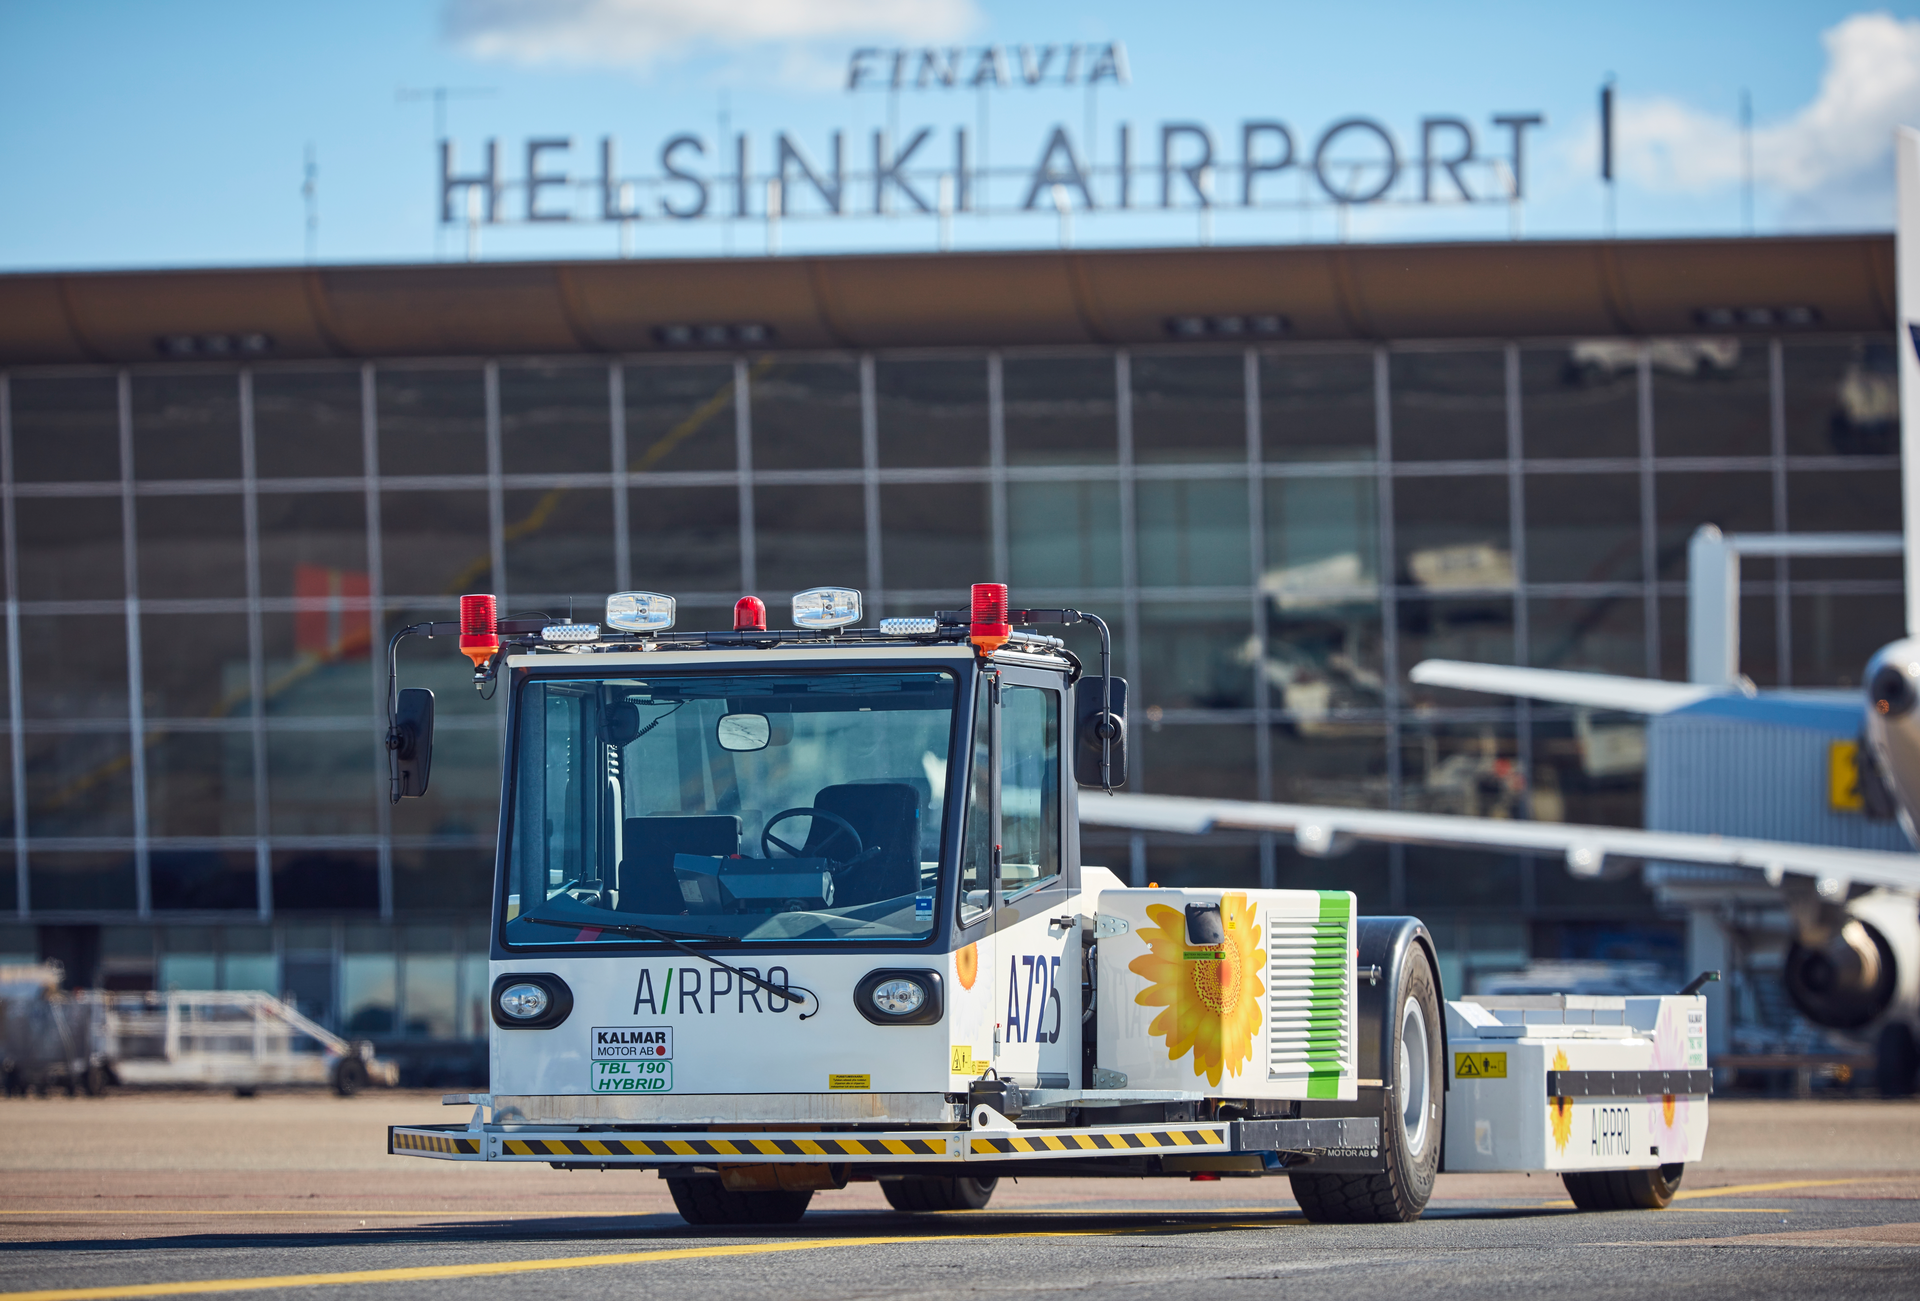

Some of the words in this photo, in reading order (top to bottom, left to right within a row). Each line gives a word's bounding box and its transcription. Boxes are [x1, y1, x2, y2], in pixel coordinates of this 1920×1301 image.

[847, 43, 1128, 89] FINAVIA
[440, 126, 970, 223] HELSINKI
[1023, 114, 1543, 210] AIRPORT
[1006, 954, 1062, 1045] A725
[597, 1031, 666, 1044] KALMAR
[597, 1046, 637, 1056] MOTOR
[639, 1046, 654, 1056] AB
[599, 1062, 631, 1074] TBL
[637, 1062, 666, 1074] 190
[598, 1078, 666, 1090] HYBRID
[1327, 1149, 1358, 1157] MOTOR
[1358, 1149, 1370, 1157] AB
